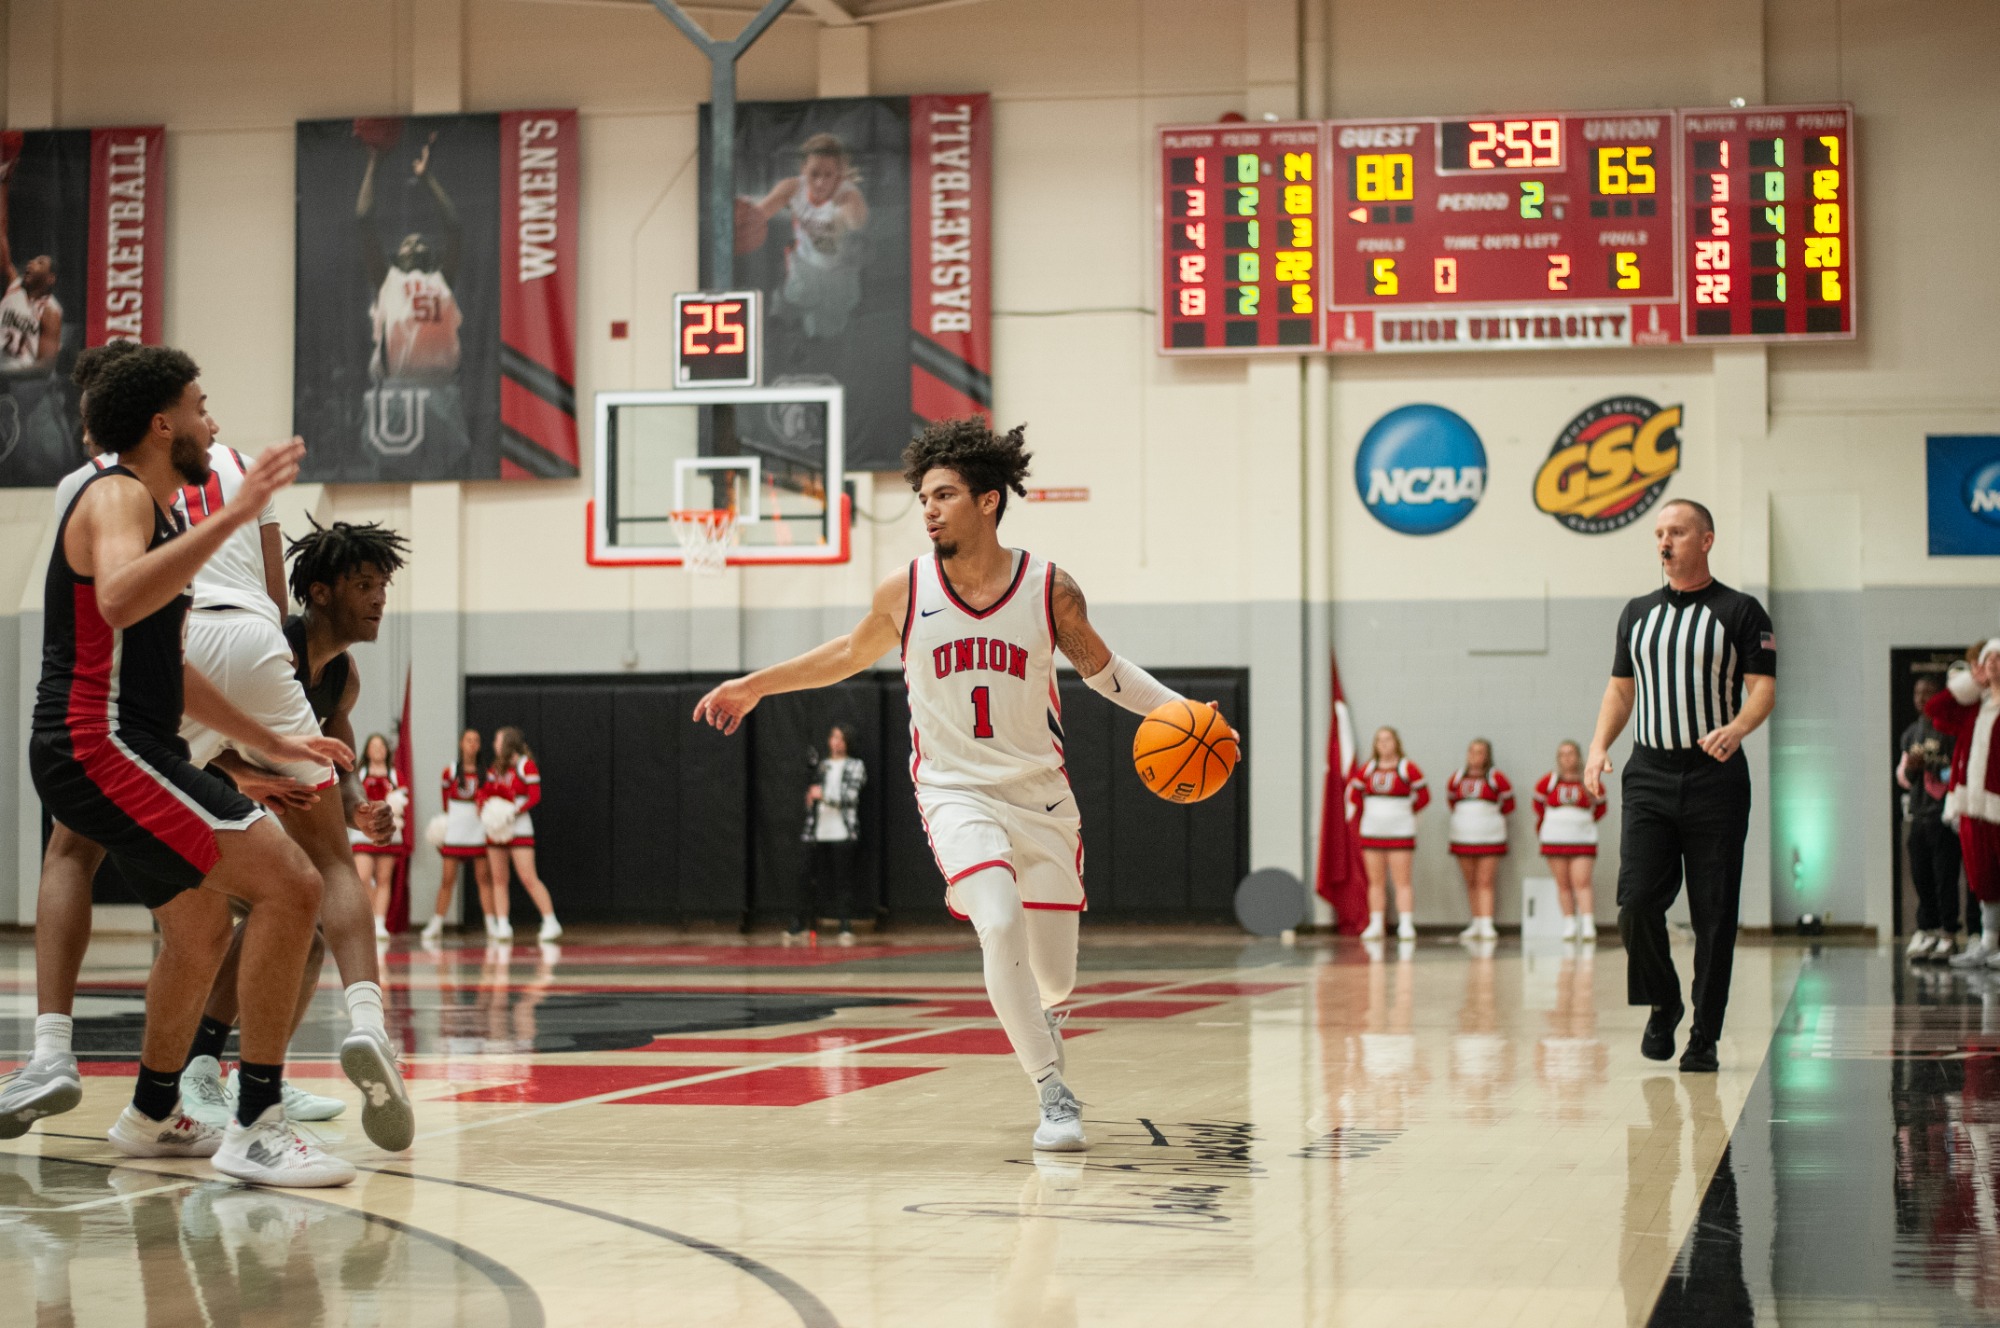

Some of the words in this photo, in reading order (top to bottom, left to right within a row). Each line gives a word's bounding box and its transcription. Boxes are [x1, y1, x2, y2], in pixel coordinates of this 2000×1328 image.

[1338, 125, 1420, 148] GUEST
[1468, 120, 1561, 169] 2:59
[1583, 118, 1661, 141] UNION
[1237, 154, 1259, 183] 0
[1356, 153, 1413, 201] 80
[1598, 146, 1656, 195] 65
[520, 119, 558, 283] WOMEN'S
[1520, 181, 1545, 219] 2
[1710, 173, 1730, 202] 3
[1764, 171, 1785, 201] 0
[1186, 189, 1206, 217] 3
[1238, 187, 1259, 216] 2
[1437, 192, 1510, 212] PERIOD
[930, 105, 972, 333] BASKETBALL
[1291, 218, 1313, 247] 3
[1711, 206, 1730, 236] 5
[1765, 204, 1785, 234] 4
[1186, 222, 1206, 250] 4
[1524, 233, 1561, 248] LEFT
[1238, 252, 1260, 282] 0
[1694, 240, 1731, 270] 20
[1804, 237, 1841, 268] 20
[1373, 258, 1399, 296] 5
[1433, 257, 1458, 294] 0
[1547, 254, 1572, 291] 2
[1615, 252, 1641, 290] 5
[1238, 285, 1260, 315] 2
[1291, 283, 1313, 314] 5
[1695, 274, 1731, 304] 22
[683, 303, 745, 355] 25
[1380, 318, 1458, 343] UNION
[1468, 314, 1627, 341] UNIVERSITY
[363, 388, 431, 456] U
[1535, 406, 1682, 515] GSC
[1366, 466, 1481, 506] NCAA
[932, 637, 1029, 681] UNION
[970, 686, 994, 739] 1
